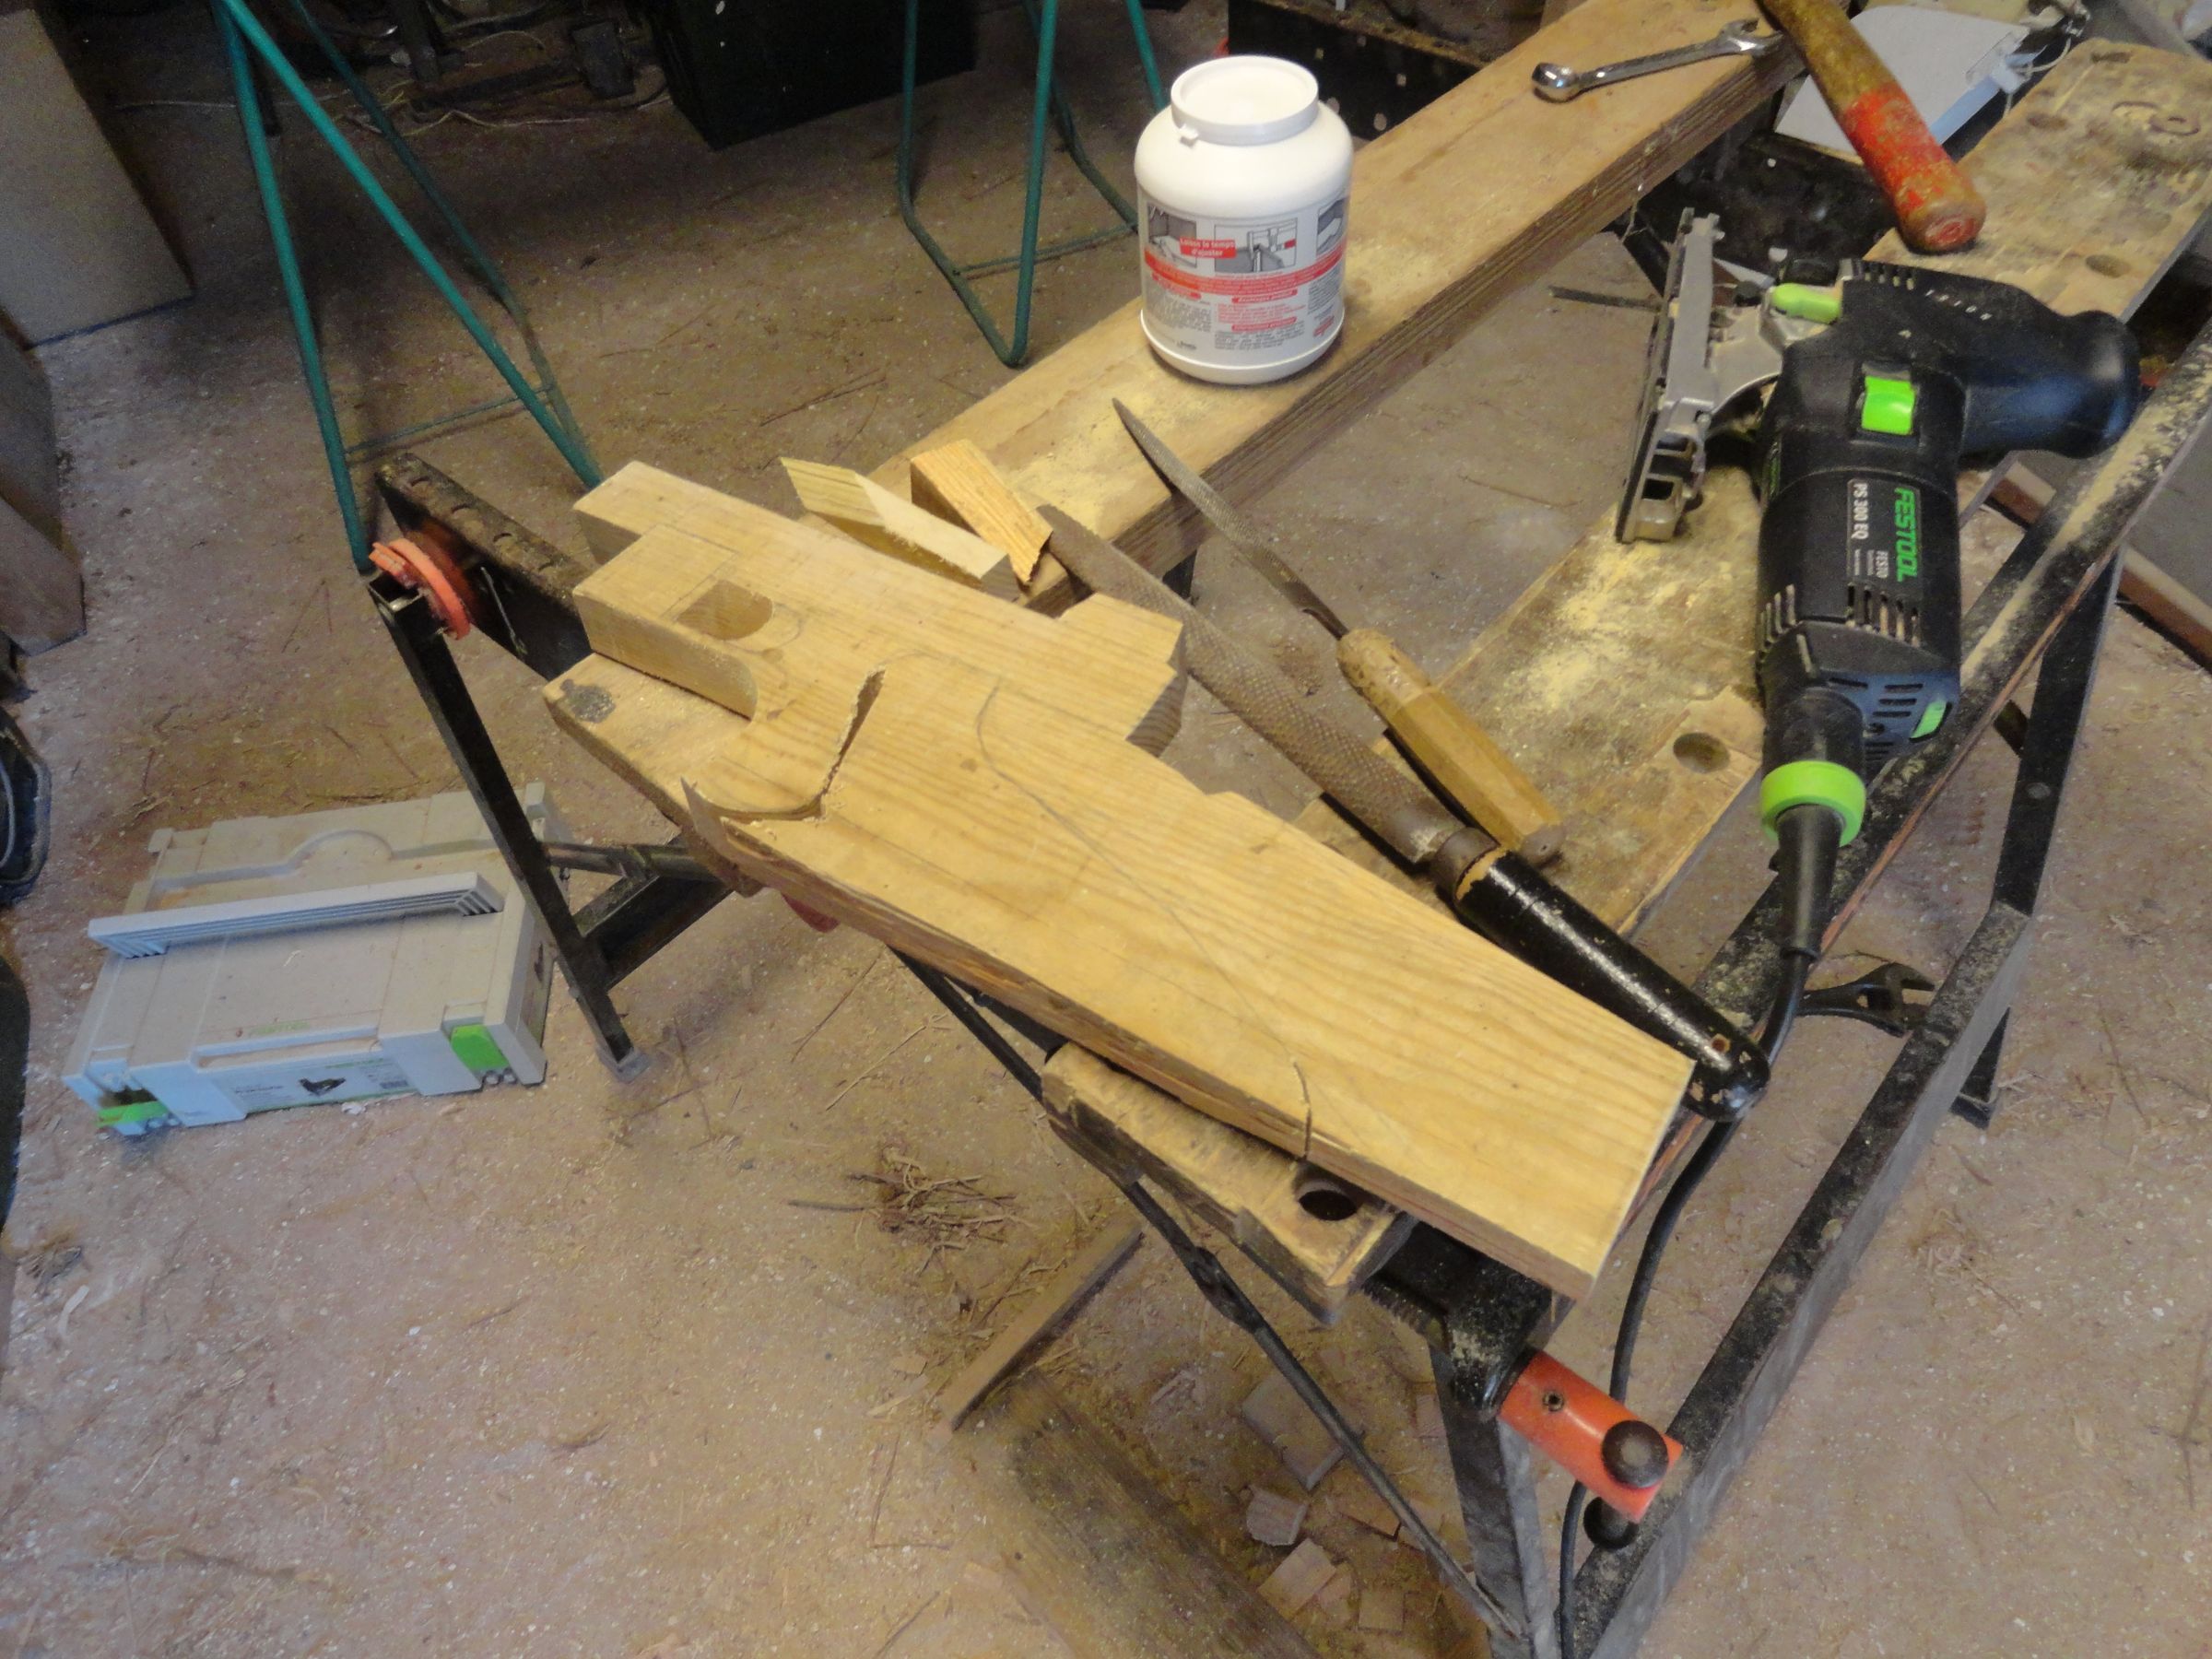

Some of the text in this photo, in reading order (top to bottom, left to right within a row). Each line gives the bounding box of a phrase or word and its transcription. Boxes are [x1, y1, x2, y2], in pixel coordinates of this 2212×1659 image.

[1853, 483, 1869, 498] PS
[1853, 500, 1868, 521] 300
[1851, 523, 1869, 540] EQ
[1894, 488, 1918, 582] FESTOOL
[1876, 550, 1888, 578] FESTO
